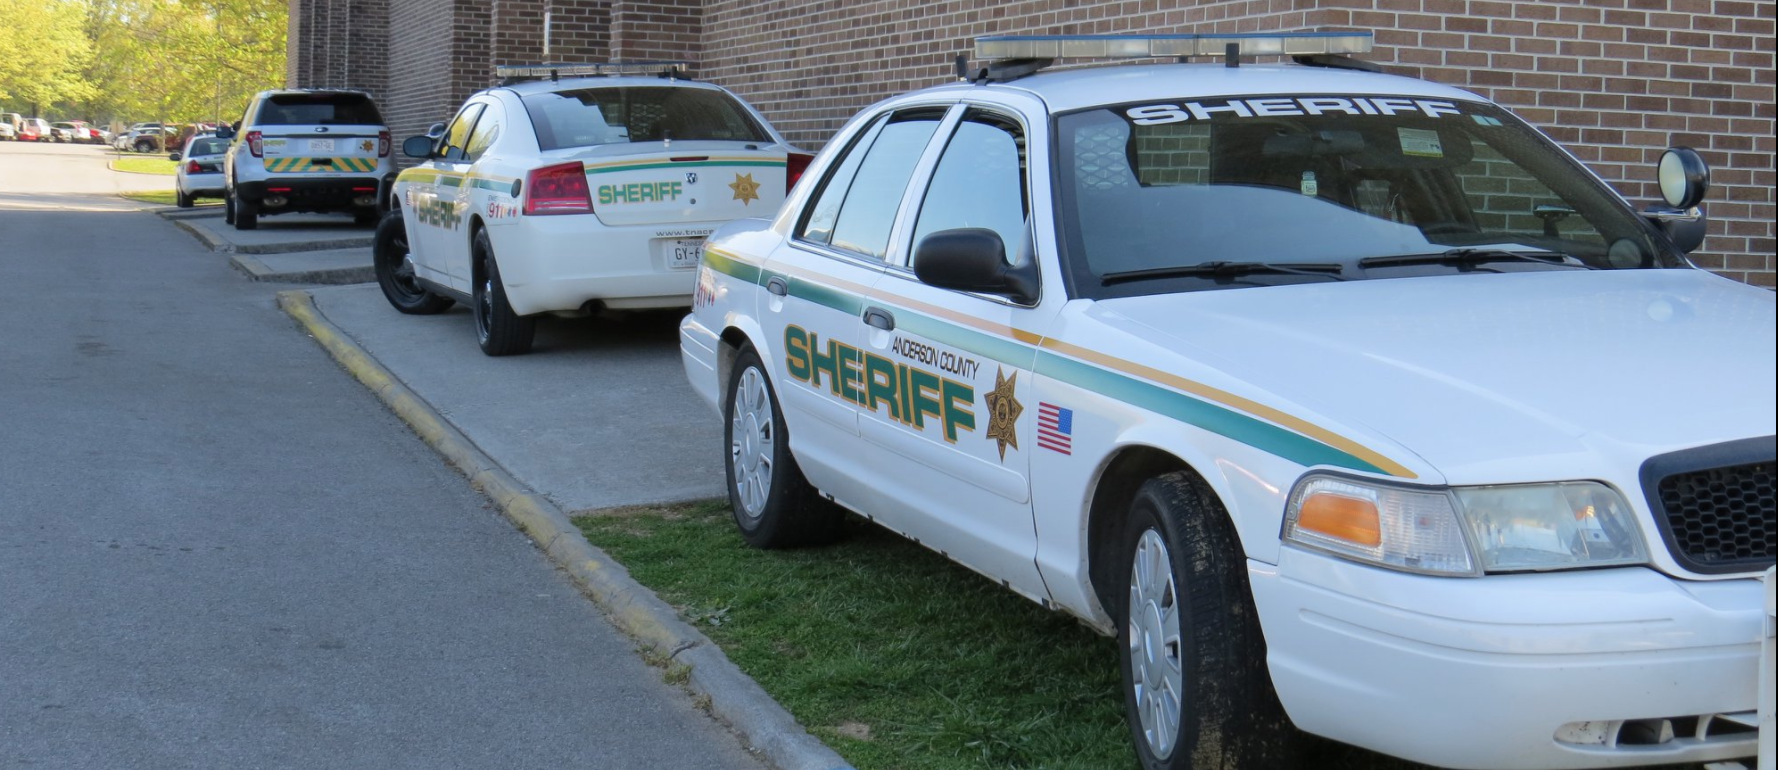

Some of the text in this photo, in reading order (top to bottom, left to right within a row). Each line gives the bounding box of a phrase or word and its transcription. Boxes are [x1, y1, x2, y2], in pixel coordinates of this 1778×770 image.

[1125, 97, 1462, 126] SHERIFF
[598, 181, 682, 204] SHERIFF
[418, 197, 463, 231] SHERIFF
[489, 202, 503, 218] 911
[892, 336, 980, 380] ANDERSON COUNTY
[784, 323, 976, 444] SHERIFF
